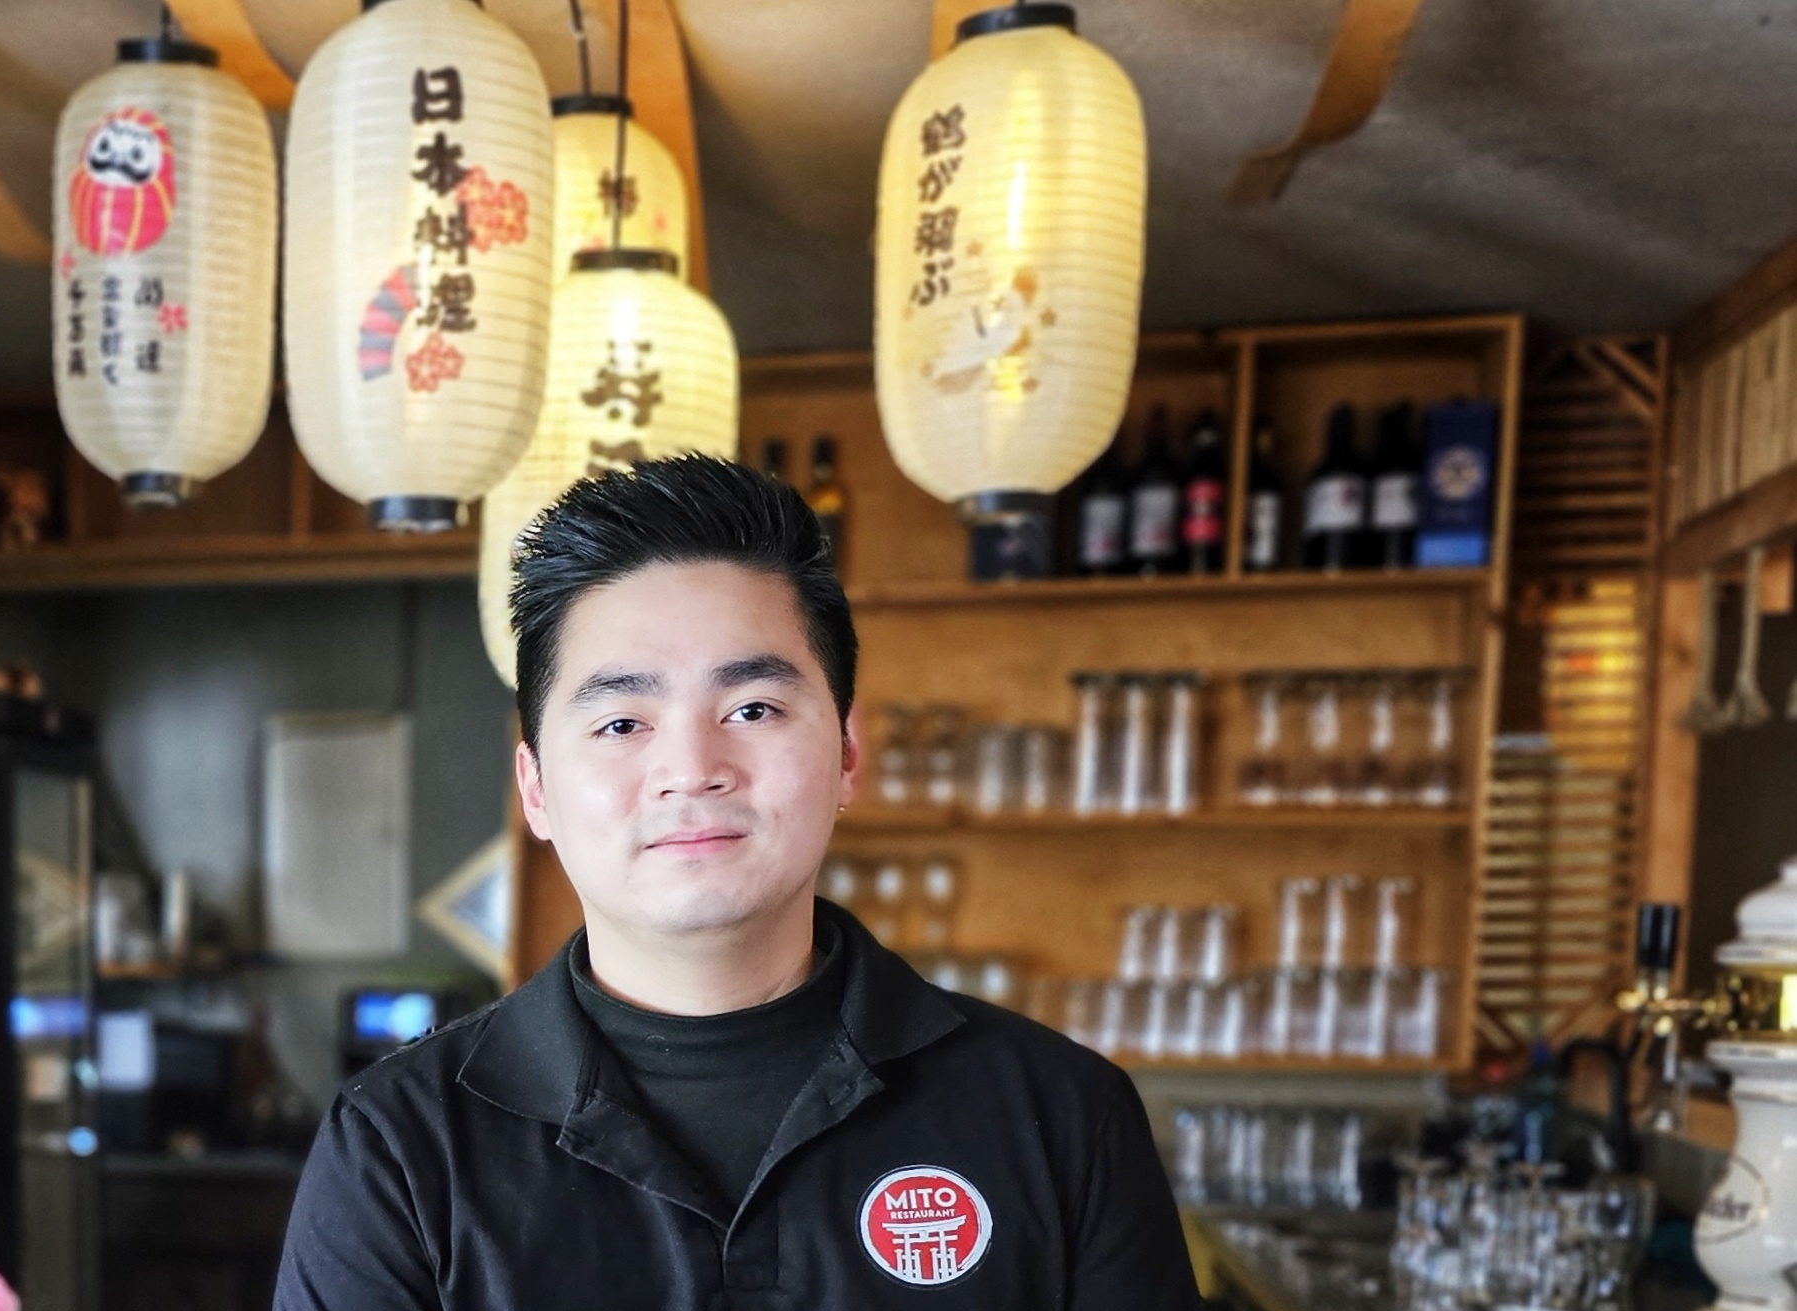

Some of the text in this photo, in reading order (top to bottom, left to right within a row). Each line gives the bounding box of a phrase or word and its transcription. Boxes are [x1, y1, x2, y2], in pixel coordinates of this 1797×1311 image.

[410, 66, 477, 332] 日本料理
[884, 1187, 957, 1211] MITO
[890, 1208, 955, 1220] RESTAURANT
